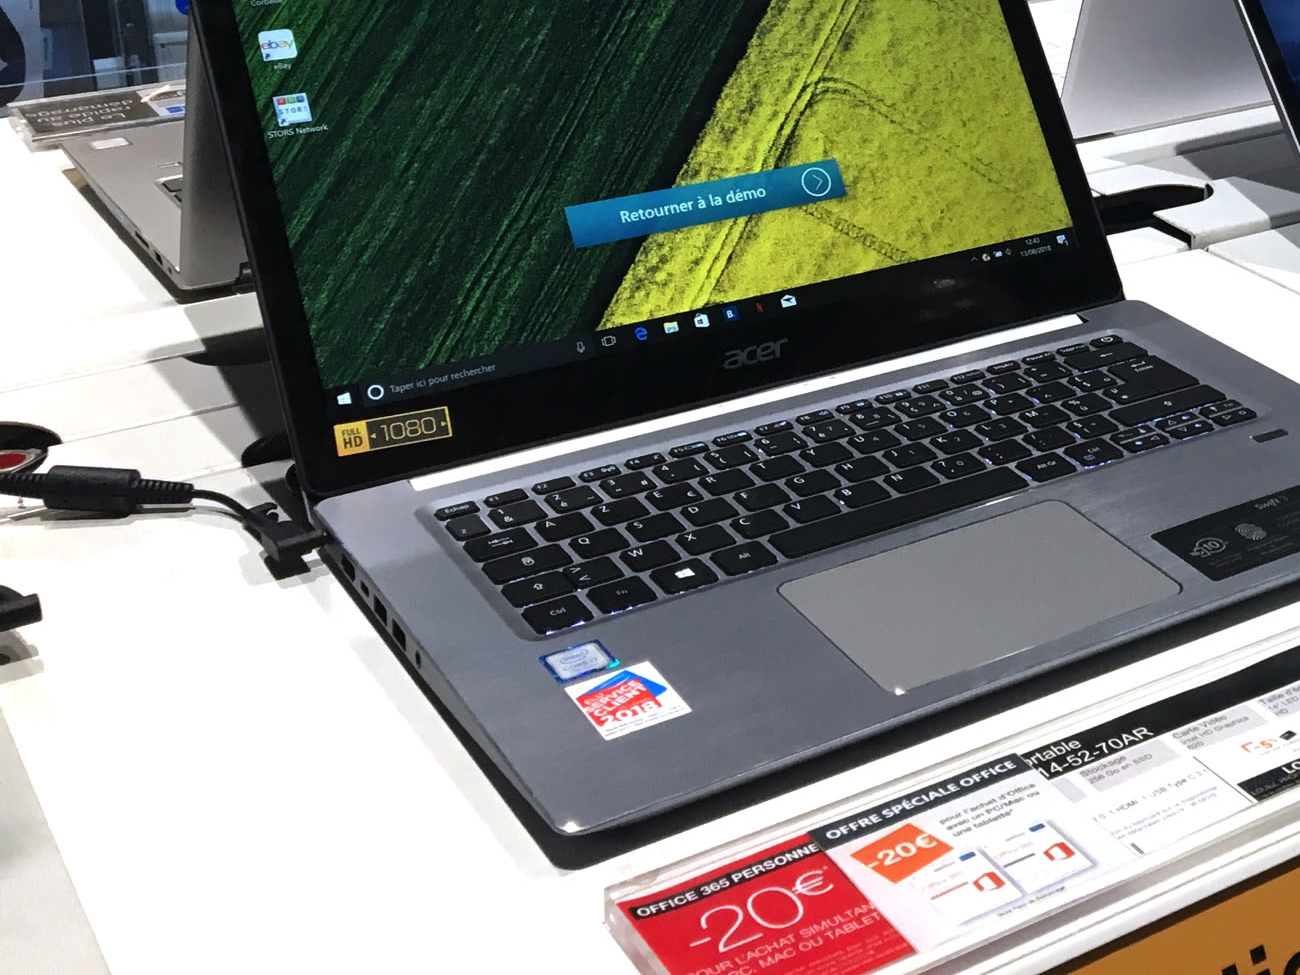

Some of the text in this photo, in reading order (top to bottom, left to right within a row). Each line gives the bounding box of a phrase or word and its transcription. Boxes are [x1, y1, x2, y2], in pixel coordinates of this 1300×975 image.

[260, 39, 294, 50] ebay
[273, 62, 292, 70] eBay
[267, 124, 328, 139] STORS Network
[619, 184, 766, 224] Retourner à la démo
[722, 335, 788, 370] acer
[389, 363, 497, 394] Taper ici pour rechercher
[341, 427, 361, 437] FULL
[380, 416, 437, 441] 1080
[343, 436, 363, 449] HD
[585, 680, 640, 713] SERVICE
[594, 683, 648, 717] CLIENT
[1258, 692, 1285, 706] Taille
[1281, 695, 1300, 707] LED
[601, 701, 660, 726] 2018
[1172, 714, 1228, 739] Carte Vidéo
[1036, 727, 1154, 776] 14-52-70AR
[1132, 753, 1153, 768] SSD
[1079, 754, 1128, 776] Stockage
[826, 760, 1017, 840] OFFRE SPÉCIALE OFFICE
[939, 810, 965, 825] pour
[867, 833, 937, 869] -20€
[636, 844, 820, 918] OFFICE 365 PERSONNE
[735, 934, 796, 965] L'ACHAT
[759, 947, 797, 969] MAC
[798, 933, 824, 952] OU
[825, 912, 881, 941] TABLET
